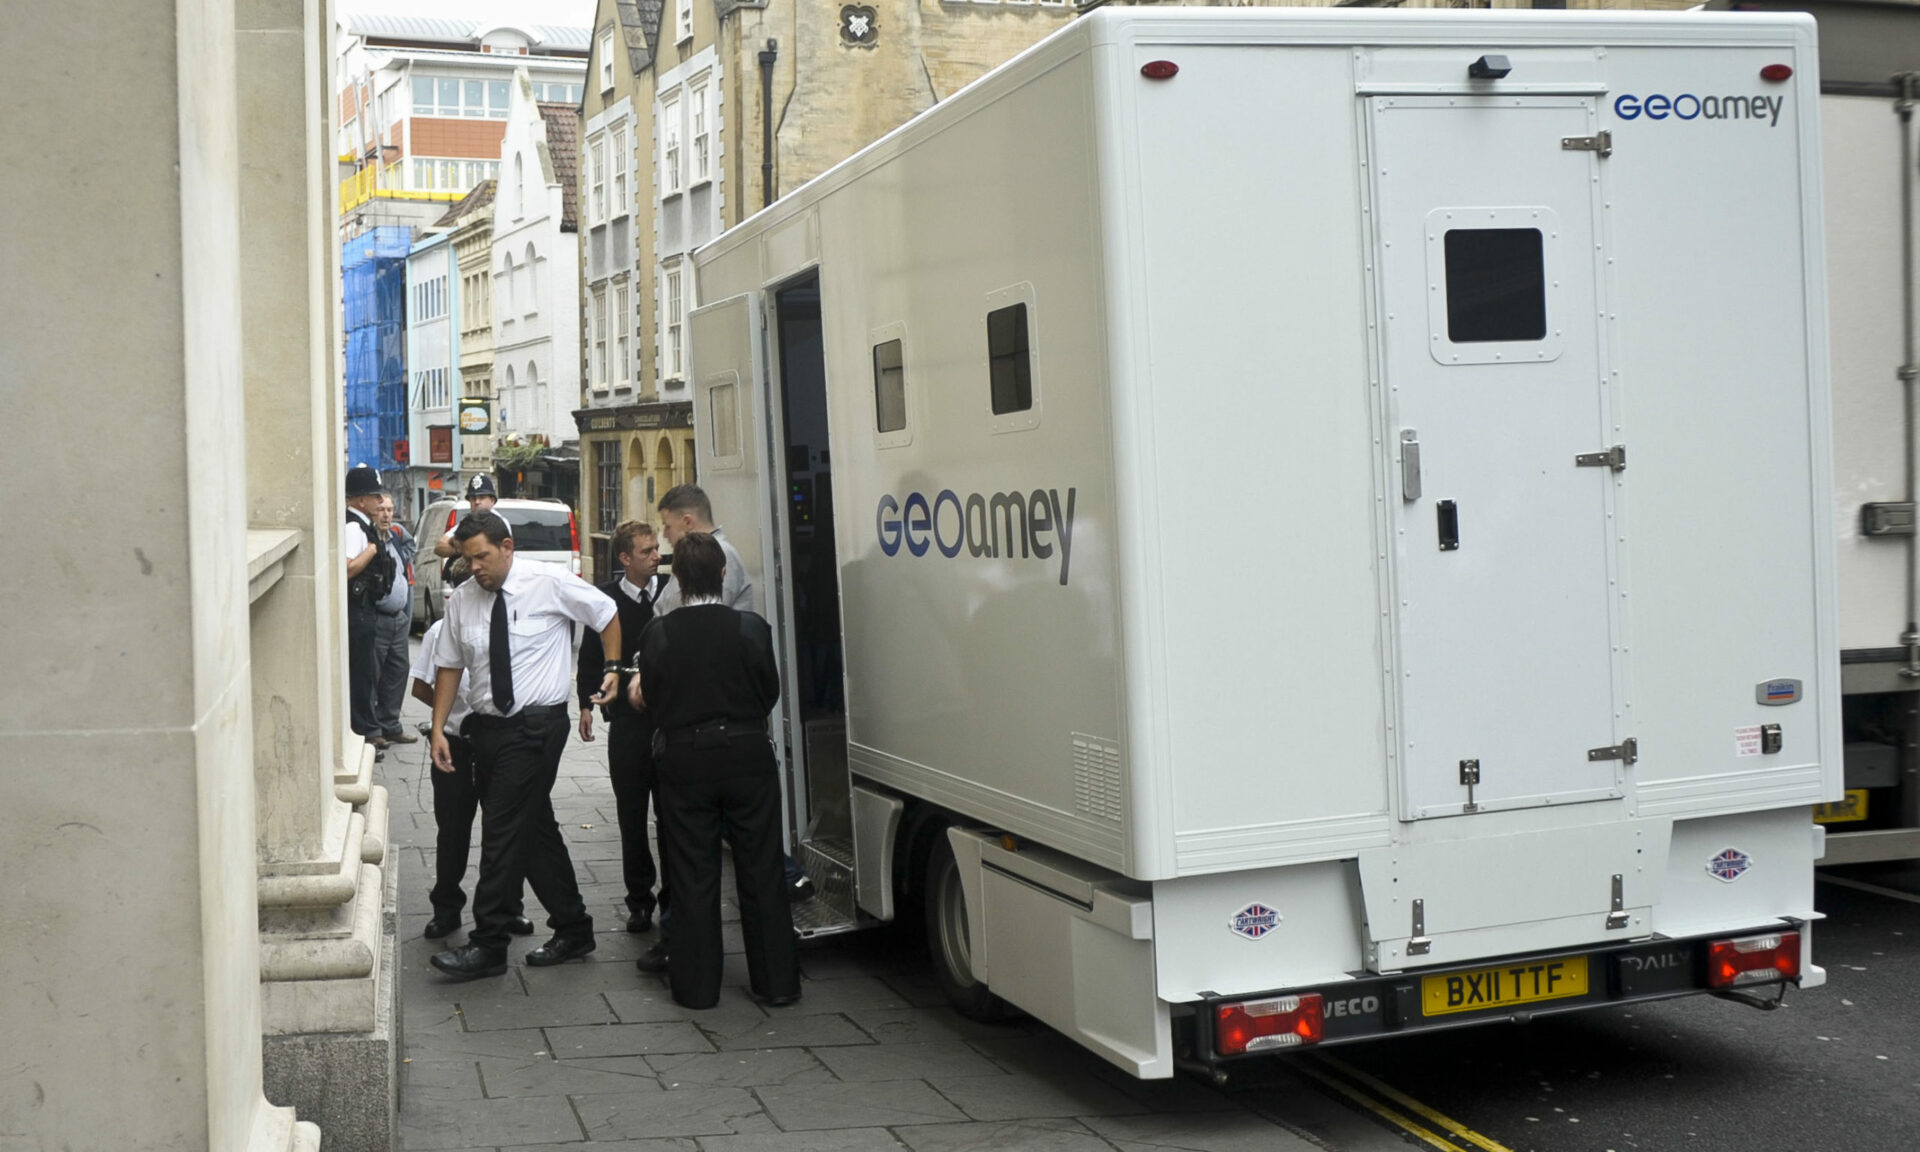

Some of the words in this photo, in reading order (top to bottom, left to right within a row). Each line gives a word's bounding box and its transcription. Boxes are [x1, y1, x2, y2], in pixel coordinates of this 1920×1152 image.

[1235, 914, 1276, 928] CARTWRIGHT
[1446, 971, 1501, 1007] BX11
[1509, 963, 1564, 998] TTF
[1322, 995, 1380, 1019] VECO
